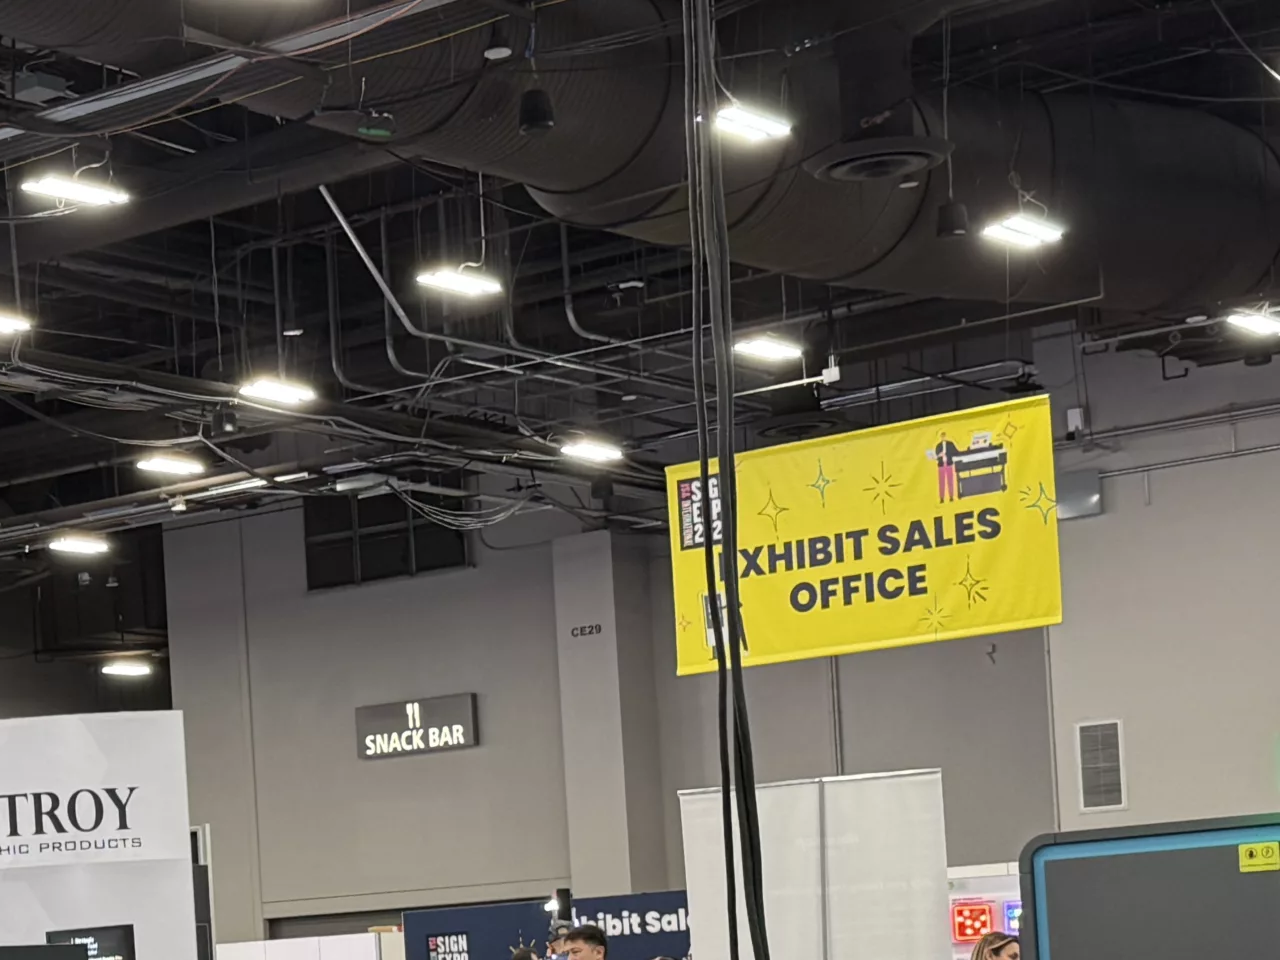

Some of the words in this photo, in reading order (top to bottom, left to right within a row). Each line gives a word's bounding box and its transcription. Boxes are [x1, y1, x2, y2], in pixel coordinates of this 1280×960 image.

[720, 528, 869, 581] XHIBIT
[877, 507, 1002, 556] SALES
[790, 563, 928, 613] OFFICE
[365, 729, 425, 755] SNACK
[428, 724, 464, 747] BAR
[39, 836, 143, 854] PRODUCTS
[580, 910, 642, 936] hibit
[645, 908, 690, 933] Sal
[436, 934, 468, 953] SIGN
